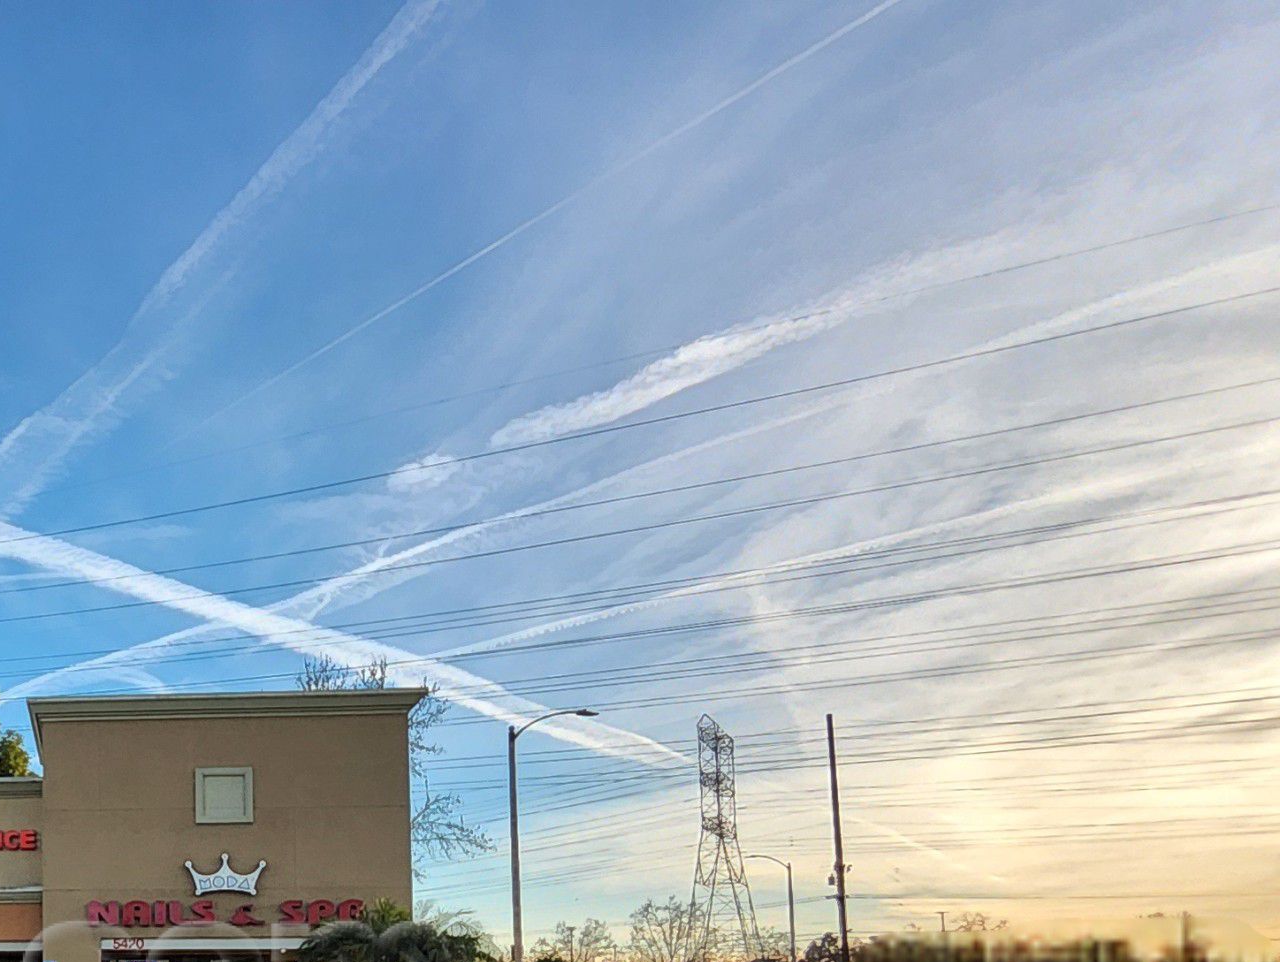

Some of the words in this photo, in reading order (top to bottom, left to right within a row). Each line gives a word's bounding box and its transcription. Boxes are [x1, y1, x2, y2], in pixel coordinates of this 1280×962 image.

[198, 875, 251, 891] MODA
[87, 900, 216, 927] NAILS
[229, 904, 266, 926] &
